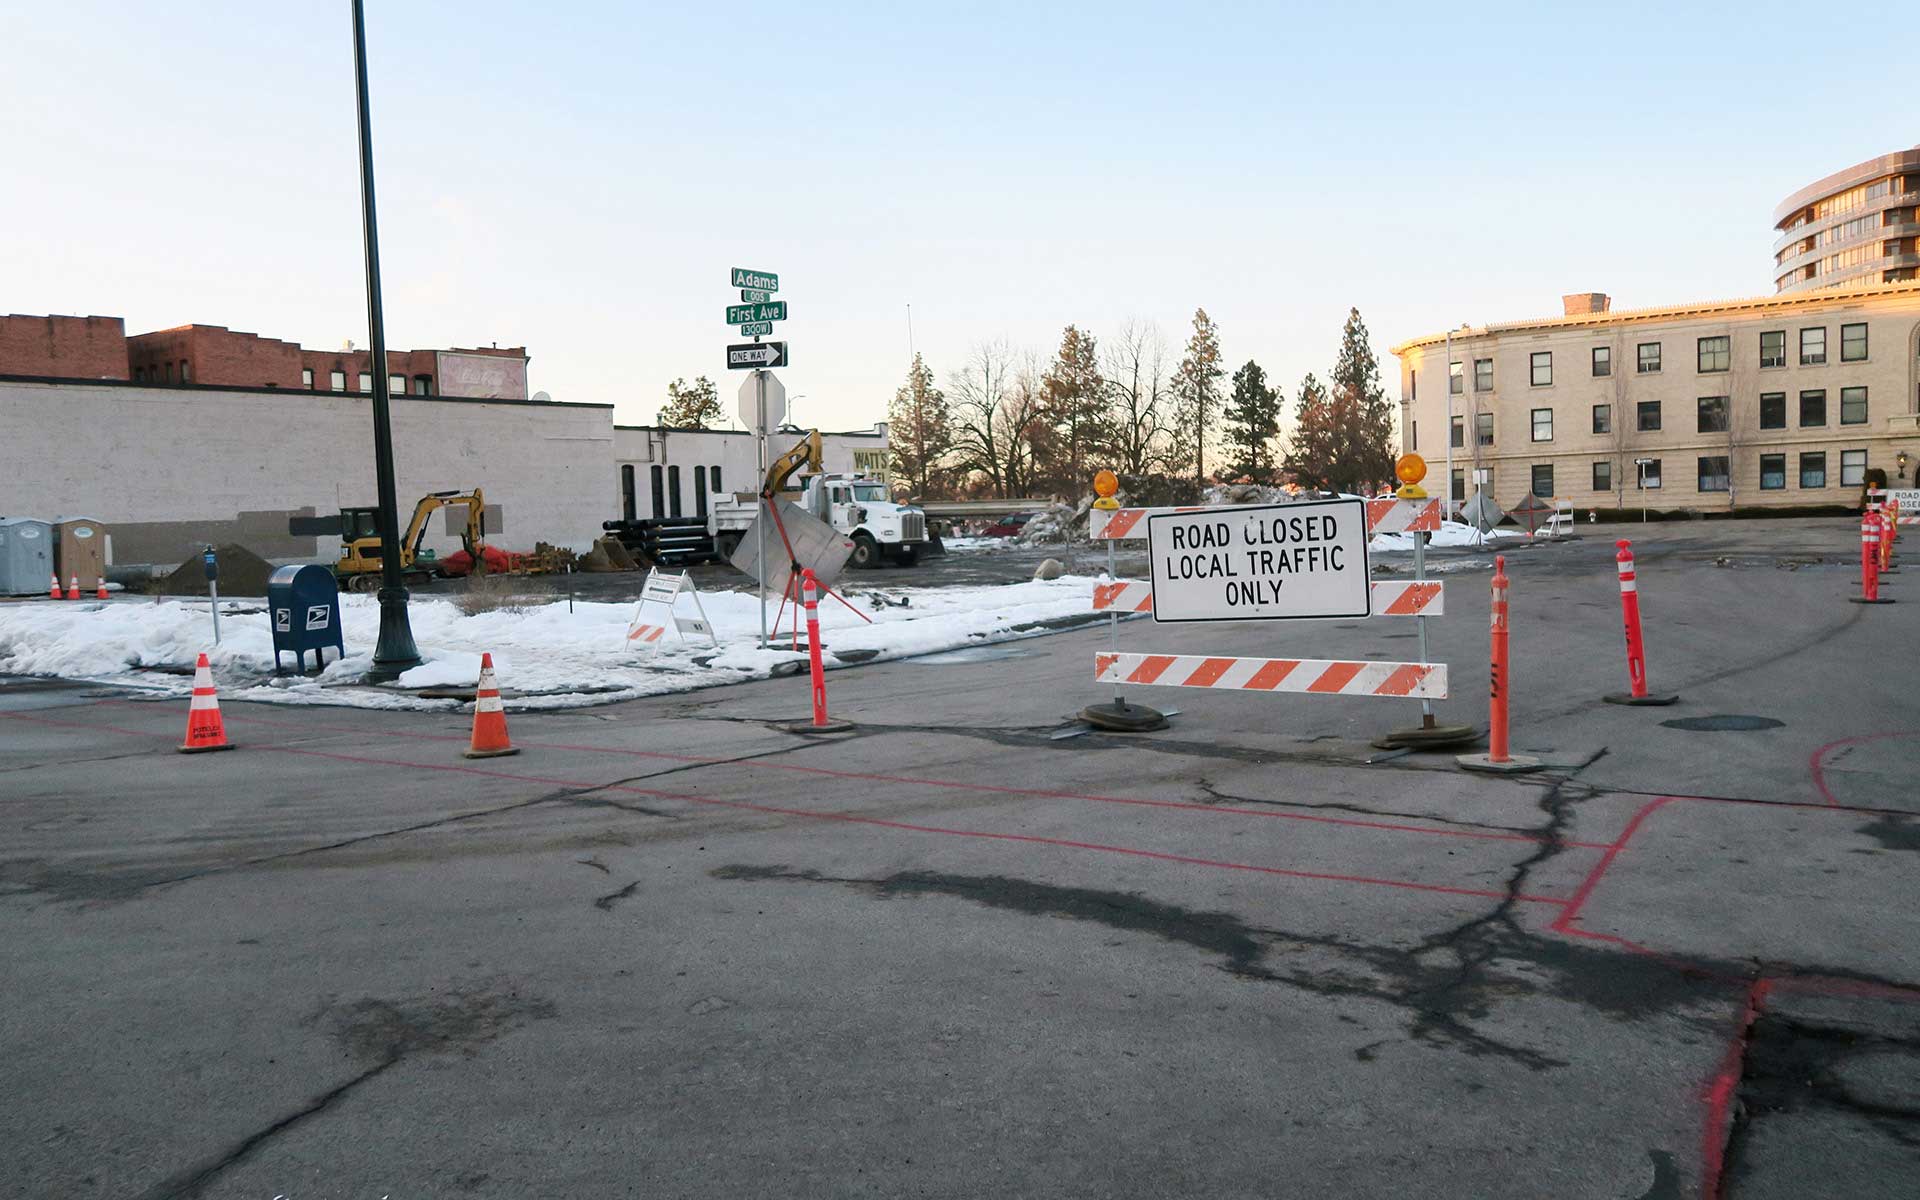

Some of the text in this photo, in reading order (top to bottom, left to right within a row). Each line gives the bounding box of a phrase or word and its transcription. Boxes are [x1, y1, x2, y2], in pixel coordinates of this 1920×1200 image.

[736, 271, 777, 289] Adams
[730, 305, 779, 322] First Ave
[732, 351, 767, 362] ONE WAY
[854, 450, 887, 469] WATT'S
[1172, 516, 1337, 549] ROAD CLOSED
[1167, 546, 1345, 580] LOCAL TRAFFIC
[1226, 580, 1283, 606] ONLY
